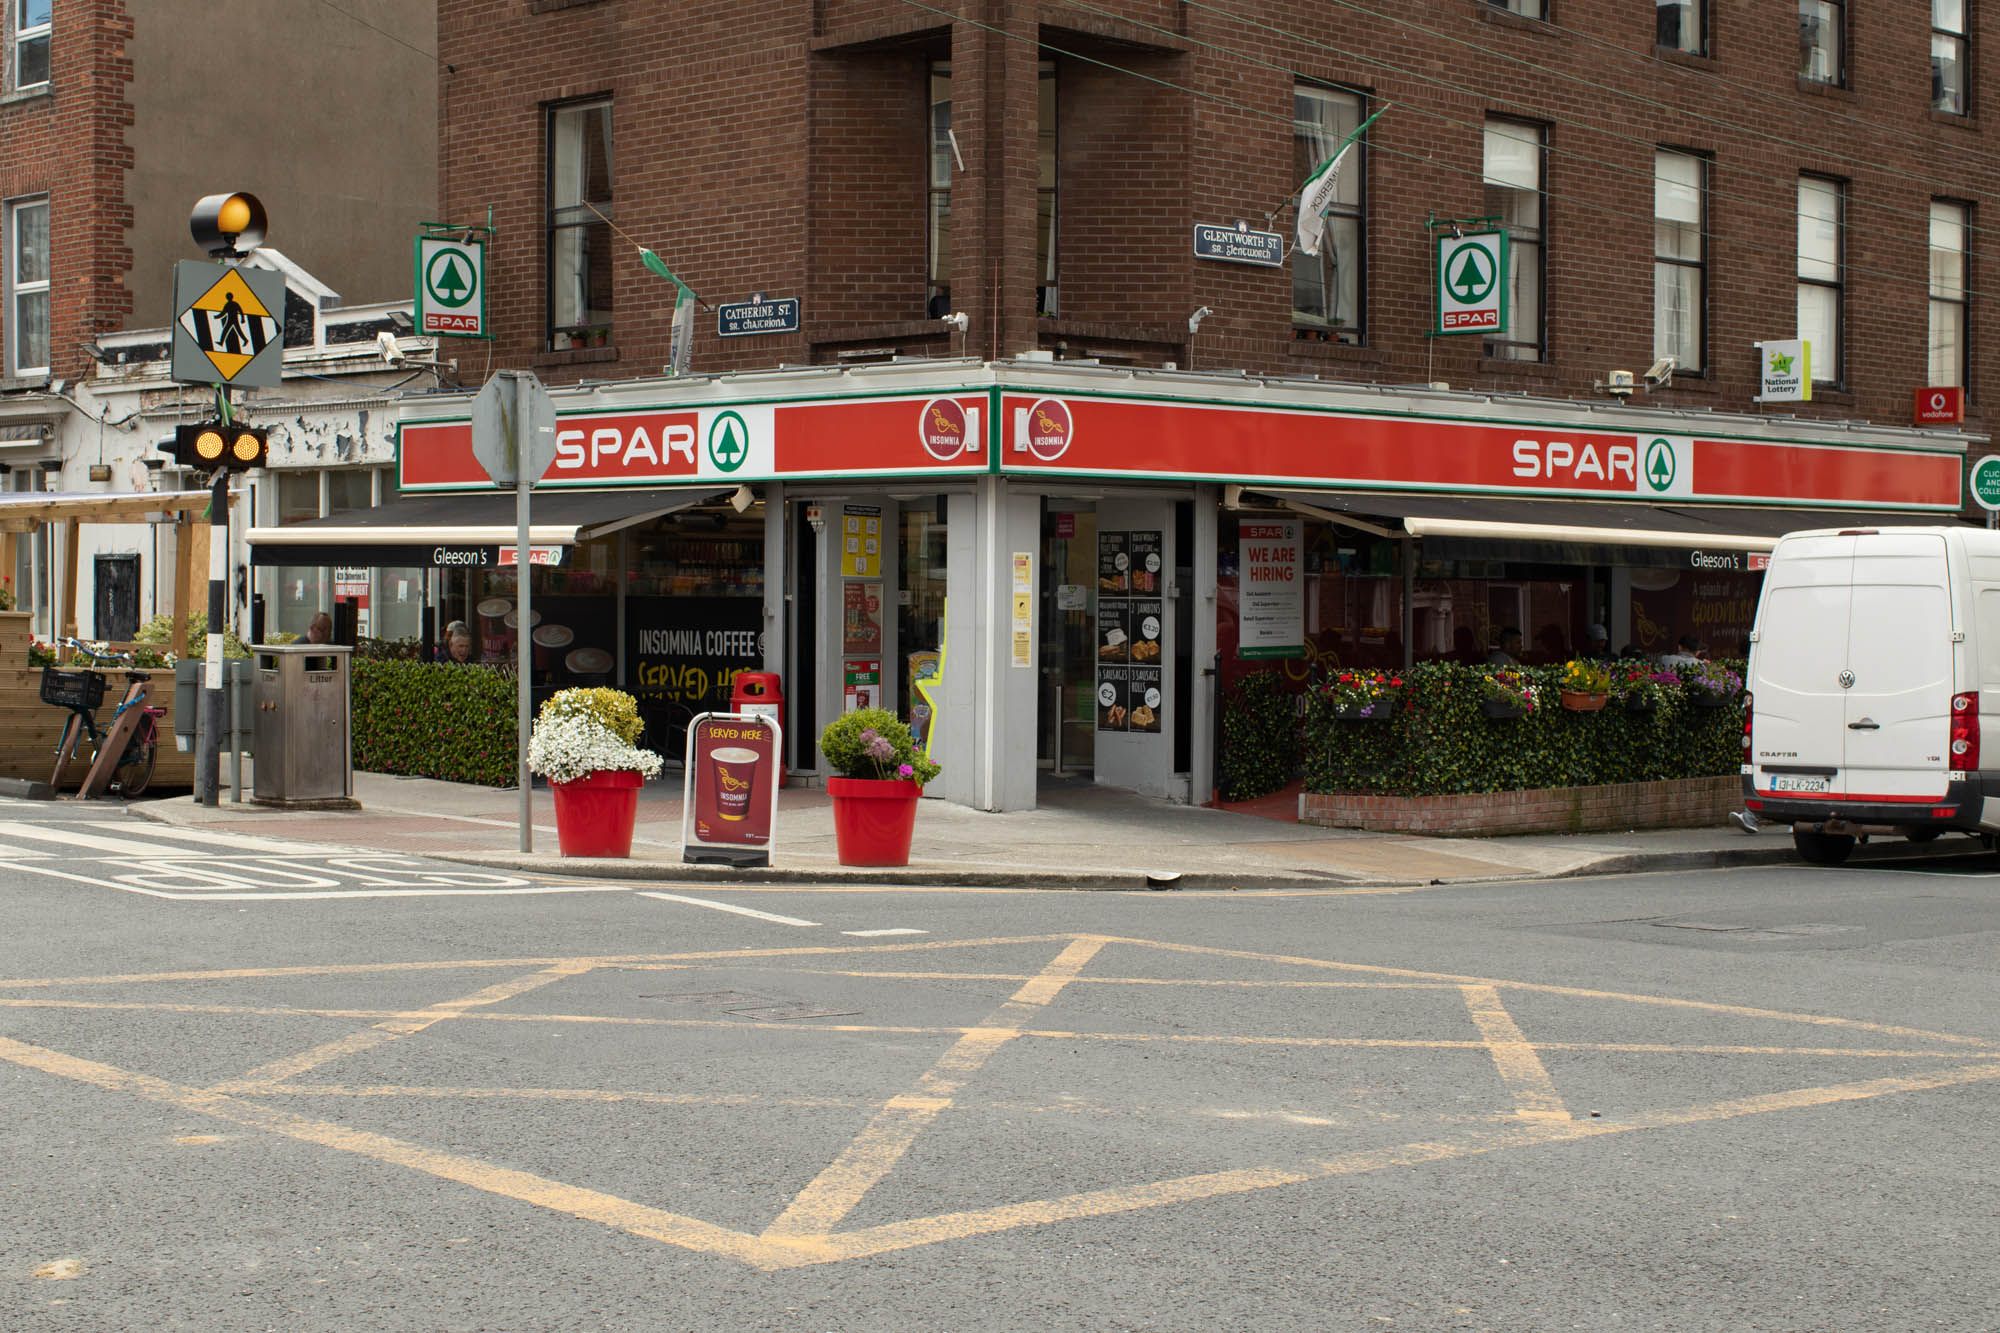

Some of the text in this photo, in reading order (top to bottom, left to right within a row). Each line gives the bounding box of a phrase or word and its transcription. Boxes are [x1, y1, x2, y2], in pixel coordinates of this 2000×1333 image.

[1203, 230, 1264, 247] GLENTWORTH
[725, 304, 791, 320] CATHERINE ST.
[1445, 312, 1496, 325] SPAR
[427, 316, 477, 328] SPAR
[1765, 377, 1799, 385] National
[1767, 385, 1797, 394] Lottery
[1922, 410, 1954, 418] vodafone
[555, 423, 695, 469] SPAR
[929, 435, 960, 446] INSOMNIA
[1034, 436, 1064, 446] INSOMNIA
[1512, 439, 1635, 482] SPAR
[1984, 470, 2000, 478] CLIC
[1978, 487, 2000, 495] COLLE
[1250, 527, 1283, 537] SPAR
[433, 546, 548, 565] Gleeson's SAR
[1248, 547, 1295, 562] WE ARE
[1691, 550, 1739, 569] Gleeson's
[1250, 566, 1294, 581] HIRING
[639, 628, 755, 656] INSOMNIA COFFEE
[638, 660, 708, 699] SERVED
[855, 672, 871, 681] FREE
[1101, 688, 1114, 701] €2
[709, 727, 763, 740] SERVED HERE
[1778, 777, 1825, 792] 131-LK-2234
